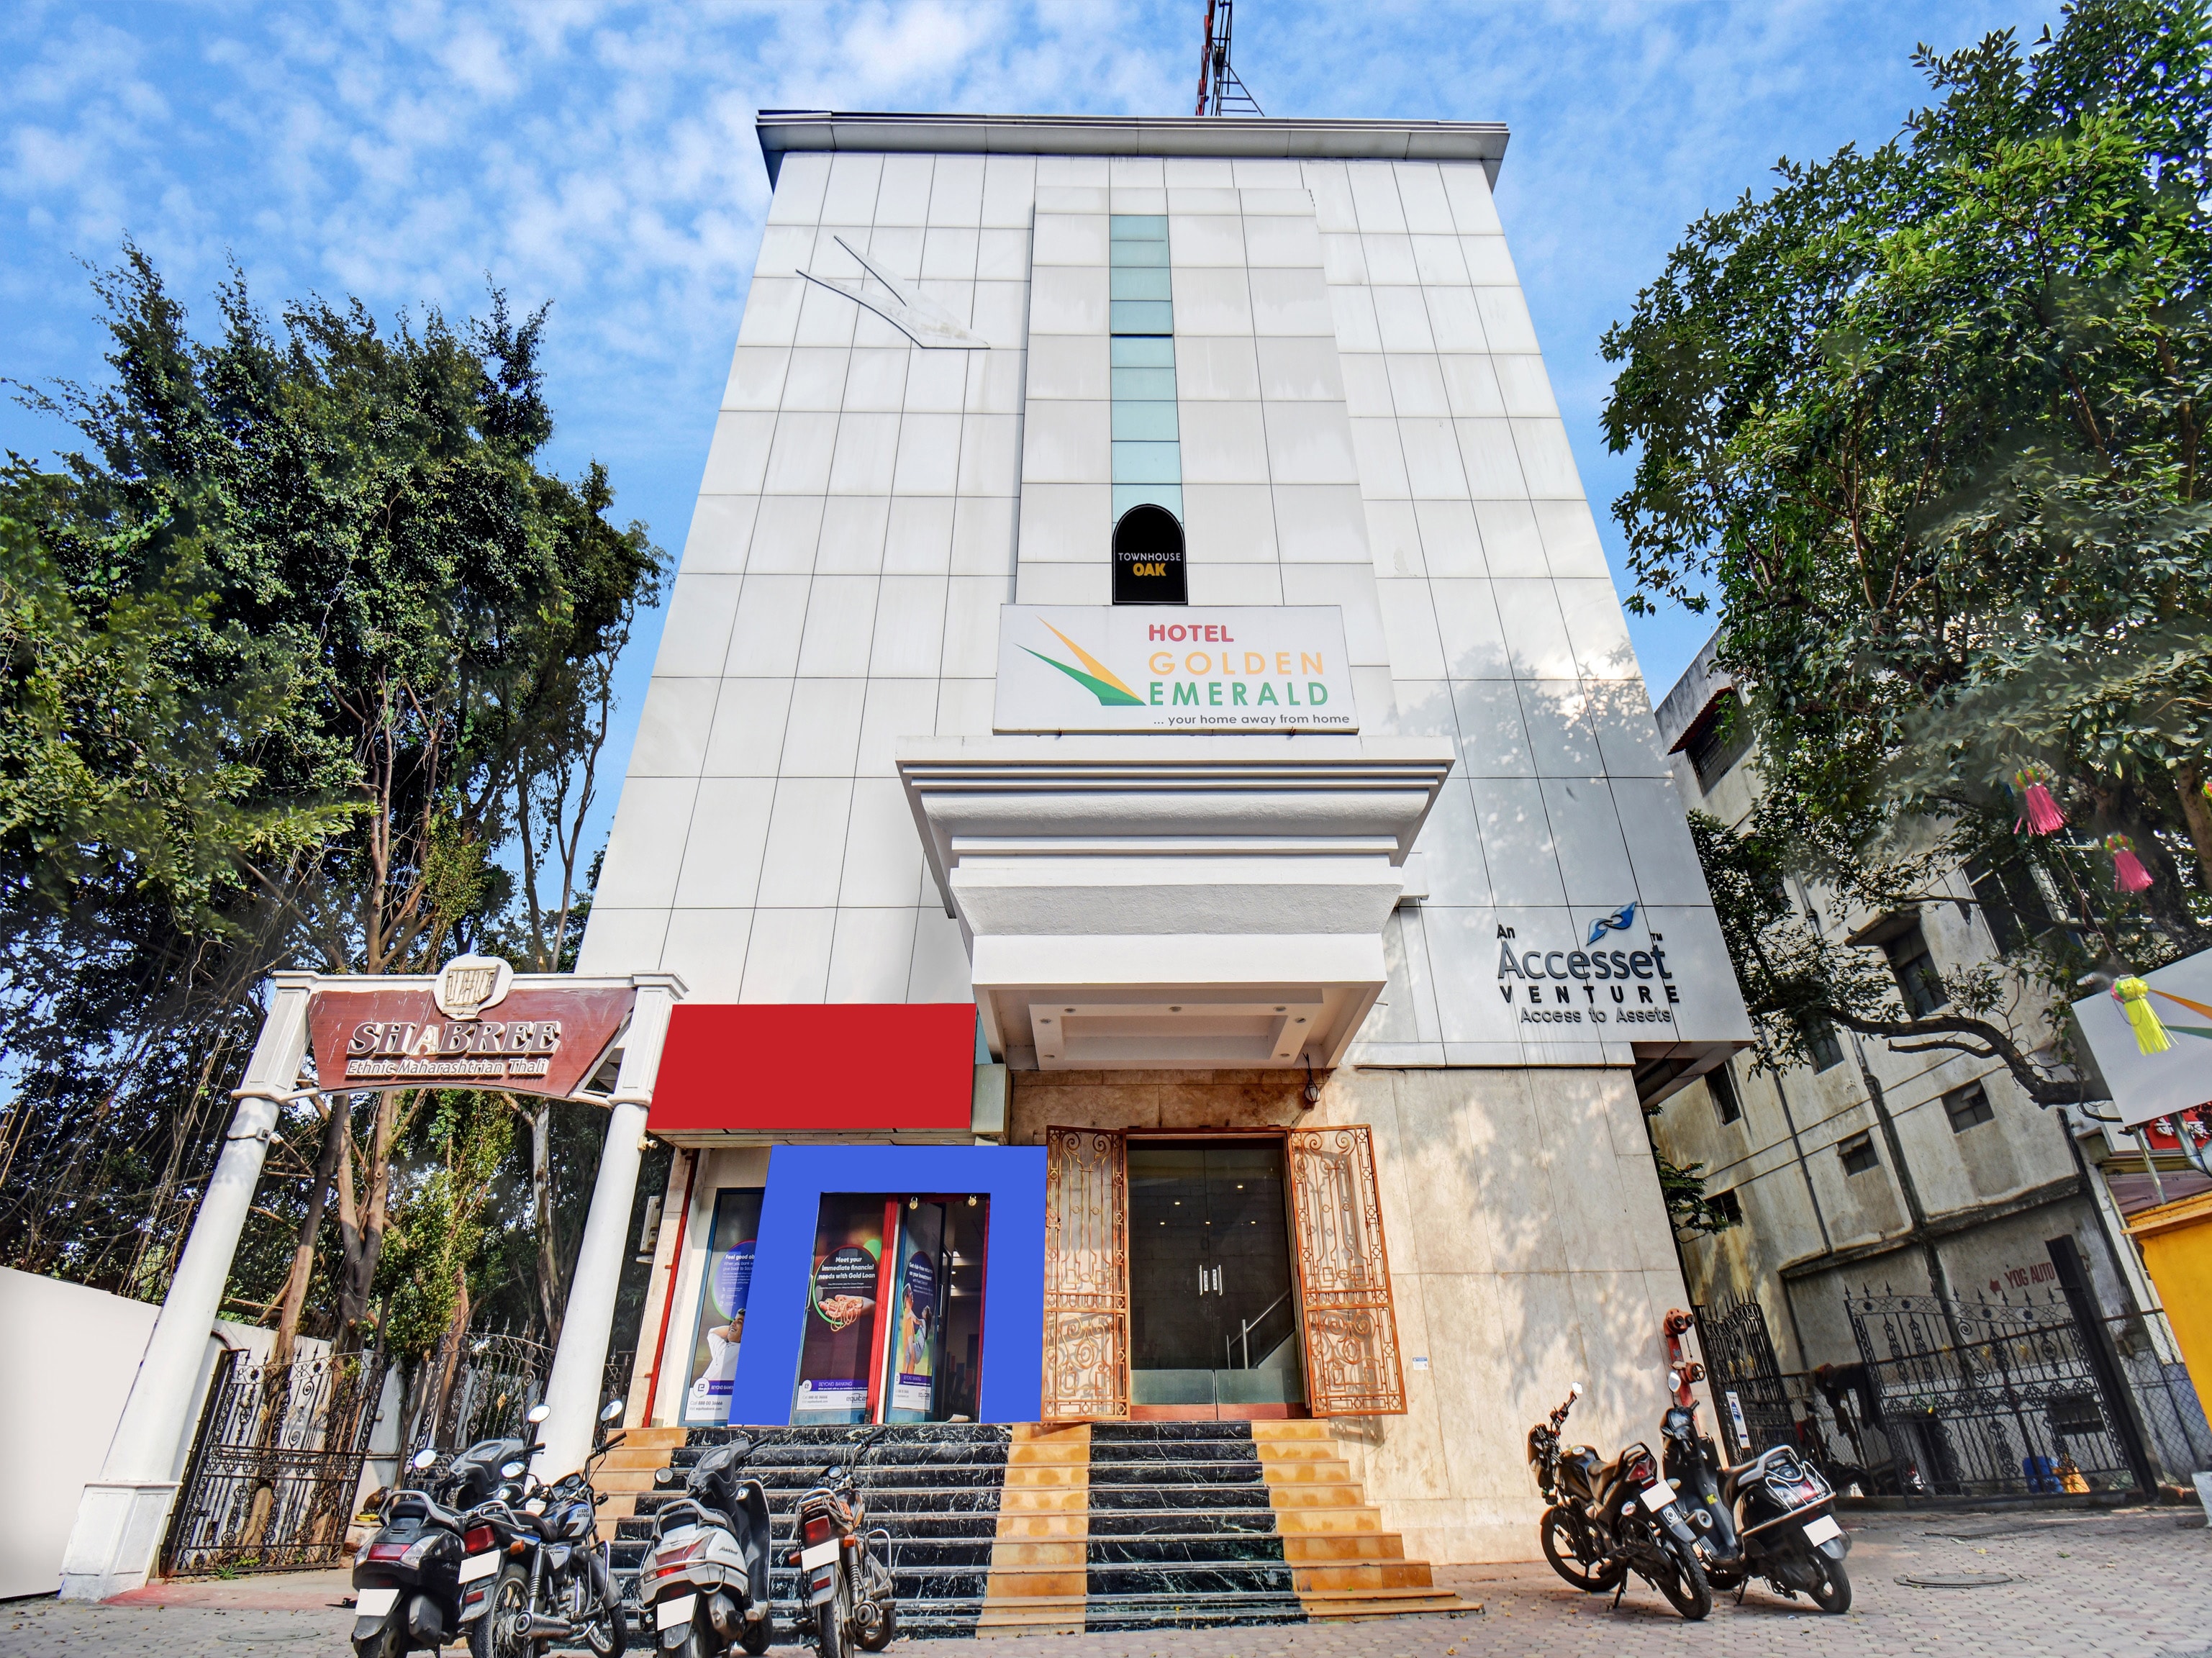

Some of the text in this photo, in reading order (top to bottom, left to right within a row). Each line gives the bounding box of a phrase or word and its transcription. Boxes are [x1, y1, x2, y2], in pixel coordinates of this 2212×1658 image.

[1118, 552, 1182, 561] TOWNHOUSE
[1133, 563, 1166, 576] OAK
[1148, 624, 1234, 643] HOTEL
[1148, 651, 1324, 676] GOLDEN
[1150, 681, 1329, 706] EMERALD
[1168, 716, 1197, 726] your
[1200, 715, 1237, 724] home
[1241, 715, 1277, 725] away
[1280, 715, 1309, 724] from
[1313, 715, 1350, 724] home
[1496, 924, 1515, 938] An
[1497, 941, 1672, 979] Accesset
[1499, 985, 1680, 1003] VENTURE
[1520, 1007, 1672, 1023] Access to Assets
[346, 1020, 562, 1058] SHABREE
[345, 1058, 550, 1077] Ethnic Maharashtrian Thali
[2004, 1261, 2056, 1289] YOG AUTO
